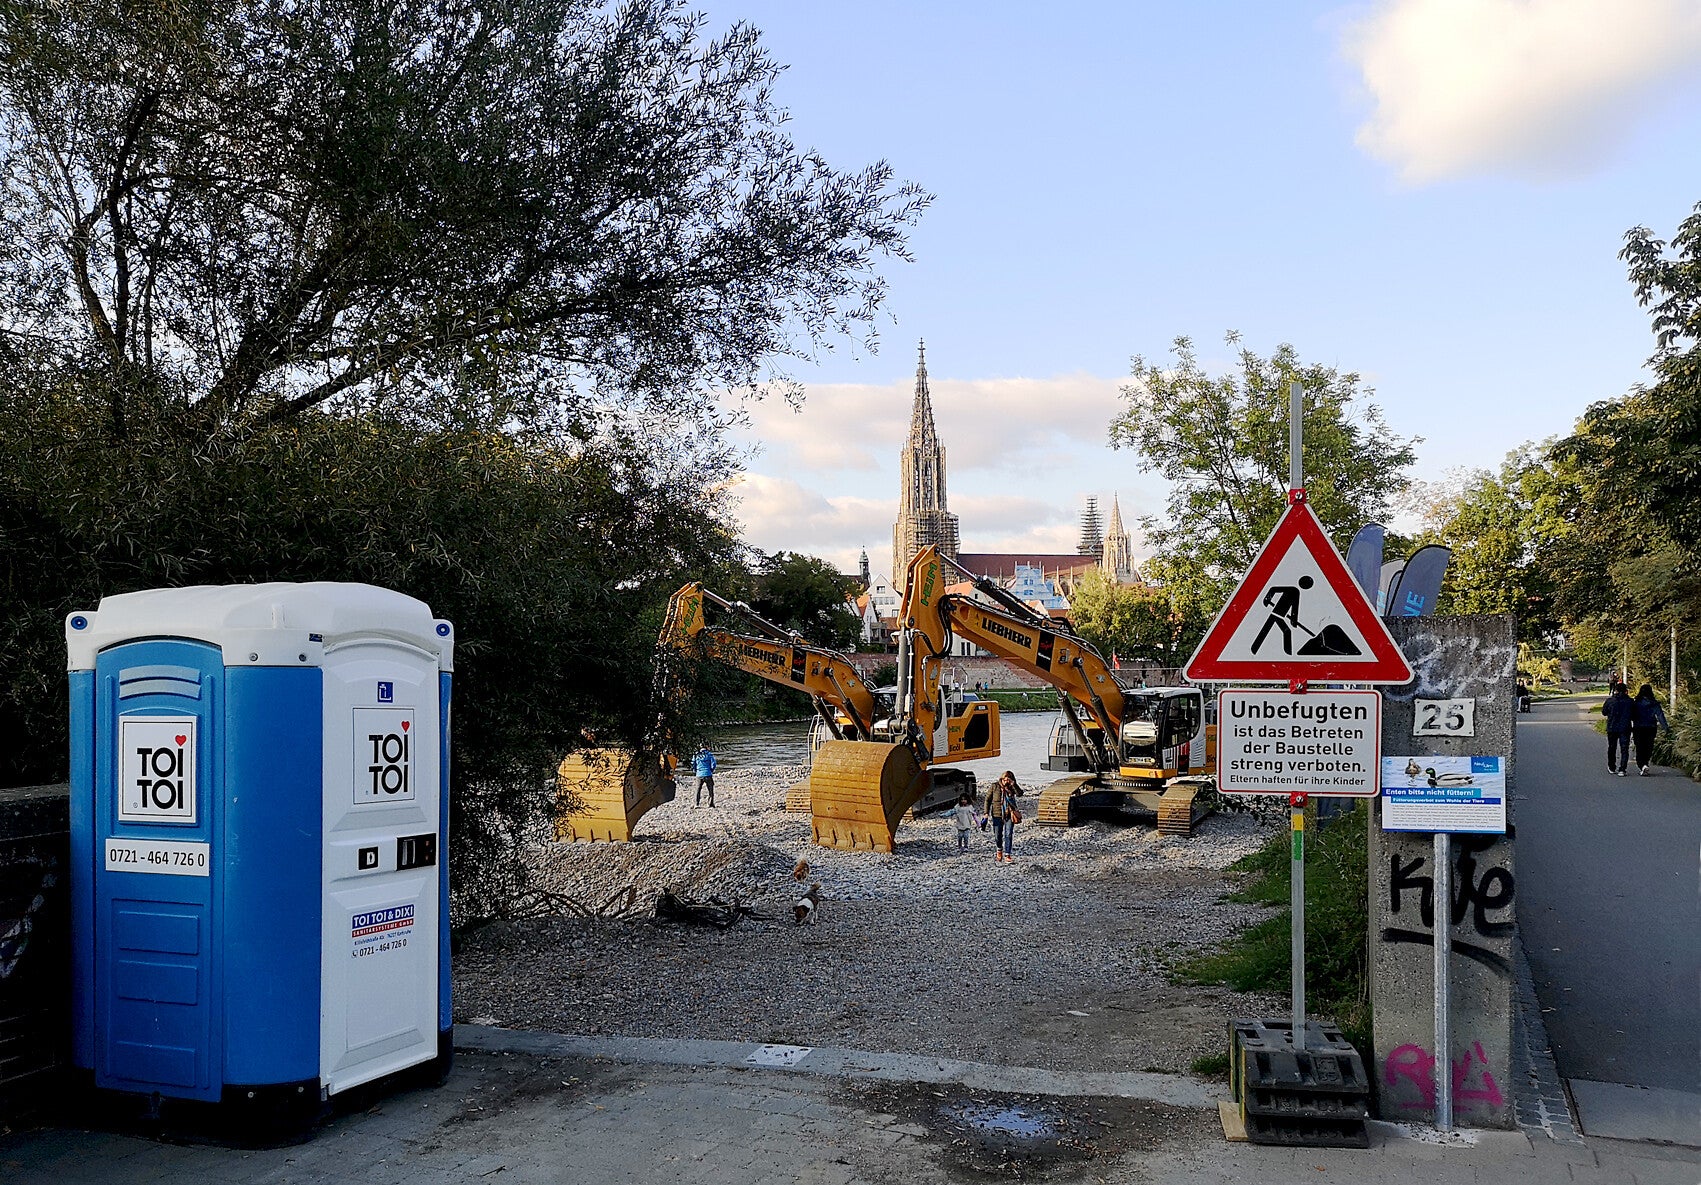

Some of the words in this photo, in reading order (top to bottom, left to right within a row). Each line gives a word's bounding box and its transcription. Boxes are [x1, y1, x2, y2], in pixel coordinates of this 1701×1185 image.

[981, 617, 1032, 649] LIEBHERR
[1231, 700, 1367, 723] Unbefugten
[1421, 704, 1464, 730] 25
[1234, 725, 1253, 737] ist
[1258, 725, 1286, 738] das
[1291, 725, 1363, 739] Betreten
[368, 733, 408, 763] TOI
[1243, 741, 1270, 754] der
[1275, 741, 1353, 755] Baustelle
[137, 747, 184, 777] TOI
[1231, 758, 1283, 773] streng
[1288, 759, 1366, 772] verboten.
[368, 764, 408, 794] TOI
[1230, 775, 1259, 783] Eltern
[1262, 775, 1292, 784] haften
[1294, 776, 1309, 784] für
[1311, 776, 1330, 785] ihre
[1333, 777, 1365, 785] Kinder
[137, 779, 184, 809] TOI
[110, 848, 138, 863] 0721
[147, 850, 169, 865] 464
[353, 915, 370, 927] TOI
[371, 911, 387, 923] TOI
[388, 910, 394, 920] &
[394, 906, 413, 919] DIXI
